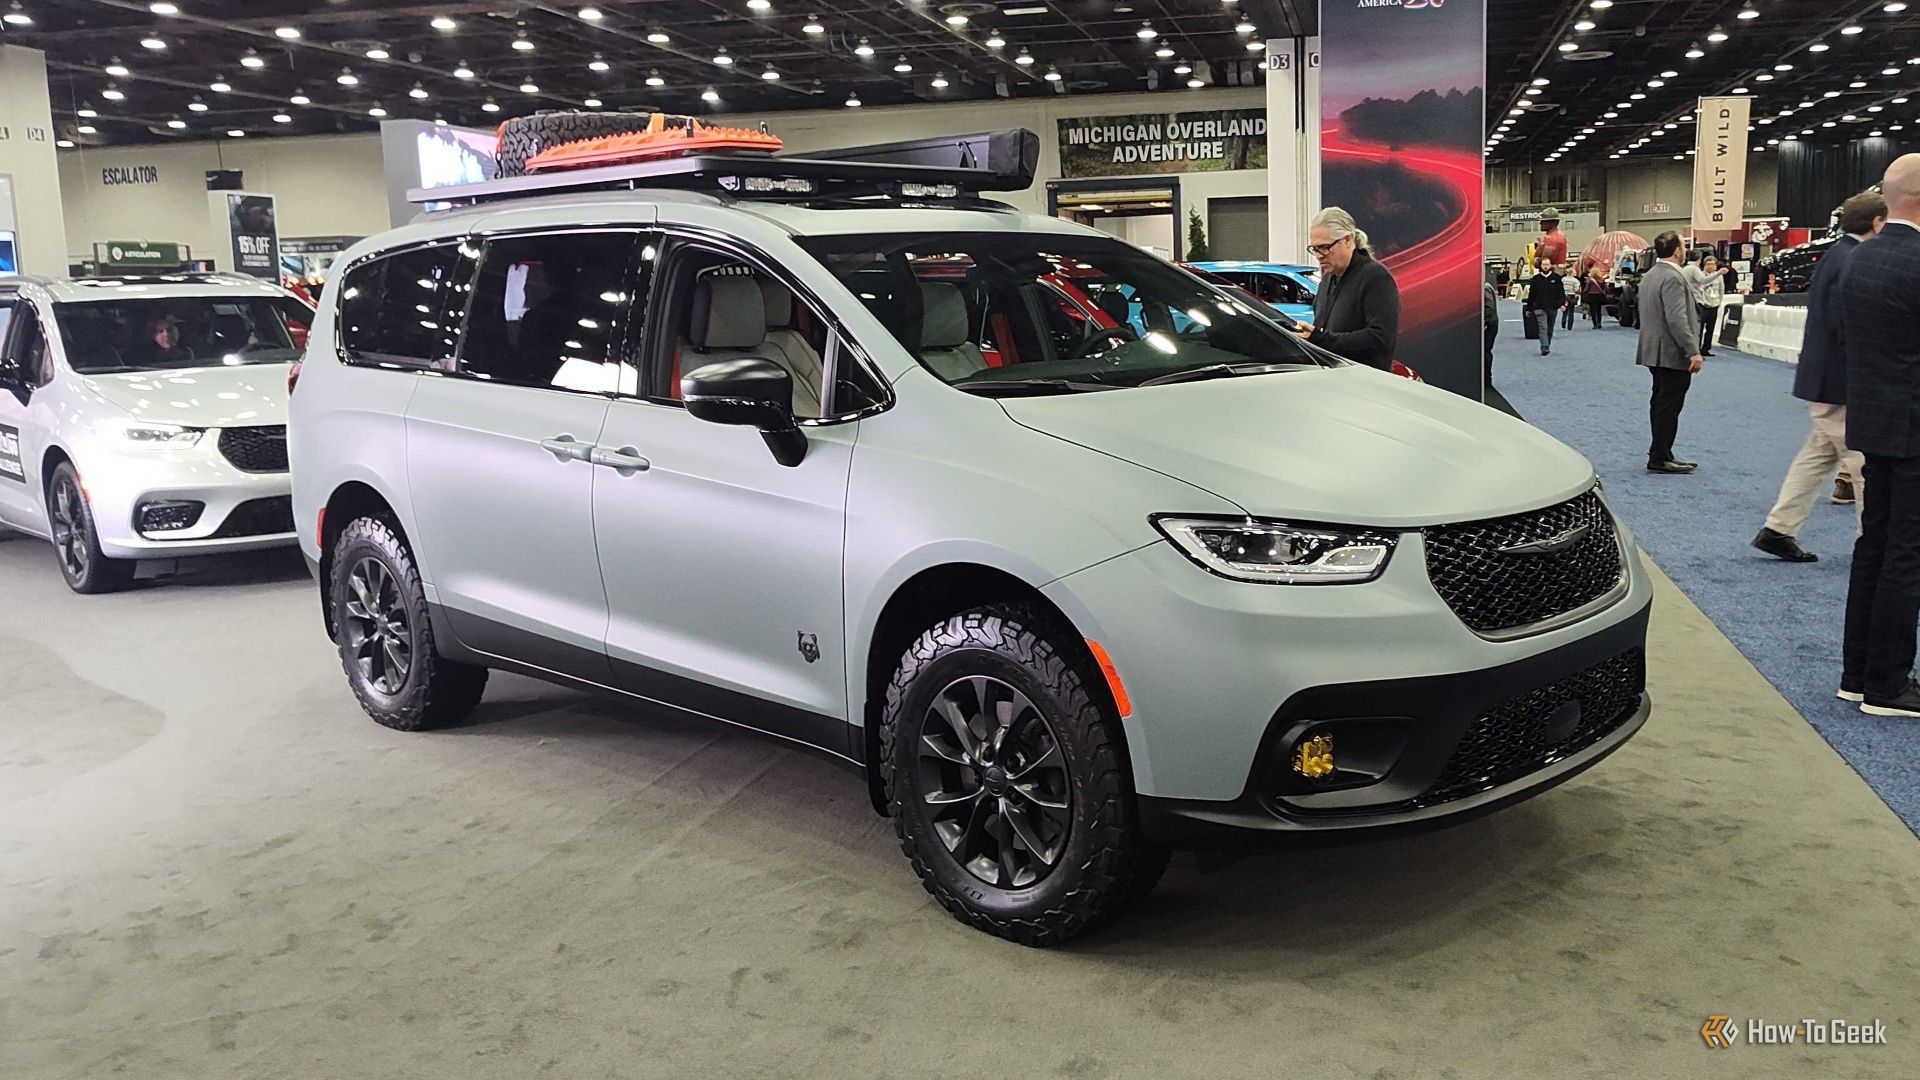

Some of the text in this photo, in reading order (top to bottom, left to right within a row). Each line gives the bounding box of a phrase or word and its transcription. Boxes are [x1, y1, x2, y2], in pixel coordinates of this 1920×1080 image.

[1270, 54, 1288, 70] D3
[1069, 118, 1267, 145] MICHIGAN OVERLAND
[1112, 142, 1224, 163] ADVENTURE
[1712, 108, 1730, 222] BUILT WILD
[102, 166, 158, 185] ESCALATOR
[238, 235, 271, 254] 15% OFF
